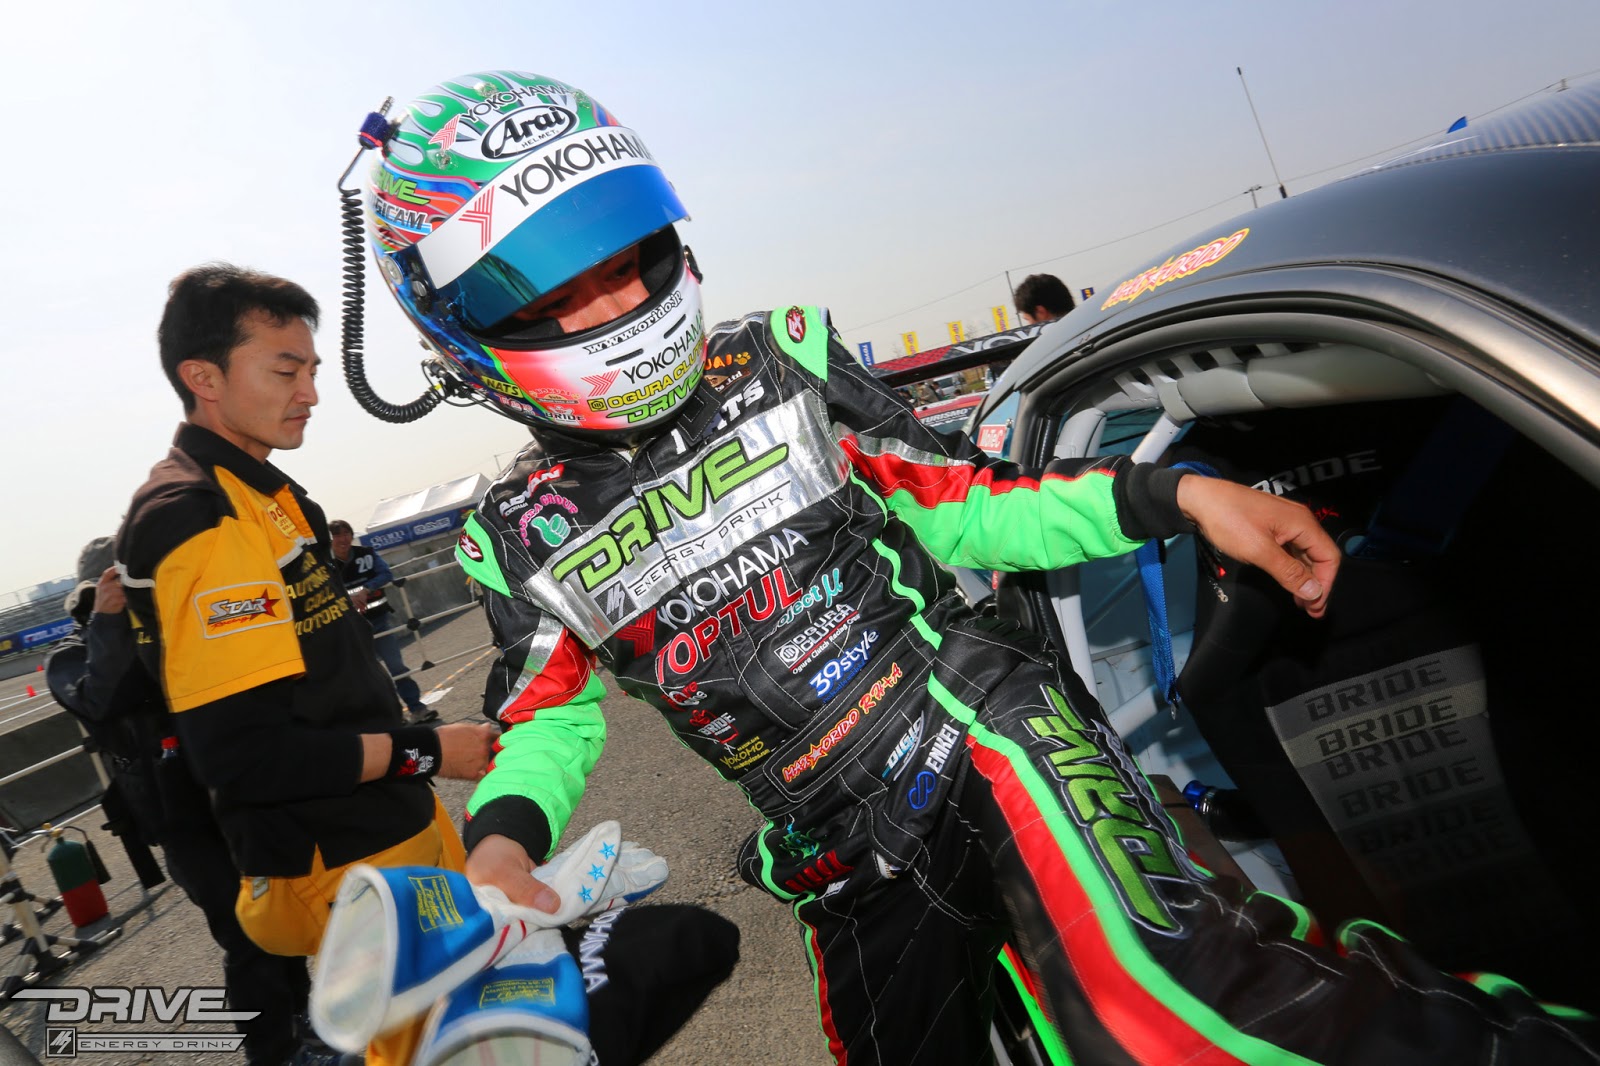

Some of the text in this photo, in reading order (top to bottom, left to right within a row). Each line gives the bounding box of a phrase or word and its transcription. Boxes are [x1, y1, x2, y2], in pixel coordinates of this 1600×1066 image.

[494, 106, 566, 157] Arai
[521, 130, 556, 148] HELMET
[485, 378, 520, 396] NATS
[606, 362, 705, 423] DRIVE
[607, 332, 705, 409] OGURA CLUT
[545, 411, 587, 421] BRIDE
[499, 463, 565, 517] ADVAN
[552, 436, 789, 593] DRIVE
[355, 554, 374, 574] 20
[634, 491, 785, 597] ENERGY DRINK
[656, 528, 810, 631] YOKOHAMA
[208, 598, 268, 619] STAR
[655, 566, 803, 685] TOPTUL
[777, 585, 824, 628] oject
[793, 603, 849, 645] OGURA
[800, 604, 856, 652] CLUTCH
[810, 630, 879, 697] 39style
[1305, 659, 1448, 722] BRIDE
[698, 712, 736, 736] BRIDE
[821, 708, 860, 753] ORIDO
[925, 723, 960, 774] ENKEI
[1315, 694, 1459, 758] BRIDE
[720, 741, 764, 769] YOKOMO
[1326, 721, 1468, 782] BRIDE
[1020, 681, 1185, 938] DRIVE
[1338, 756, 1485, 819] BRIDE
